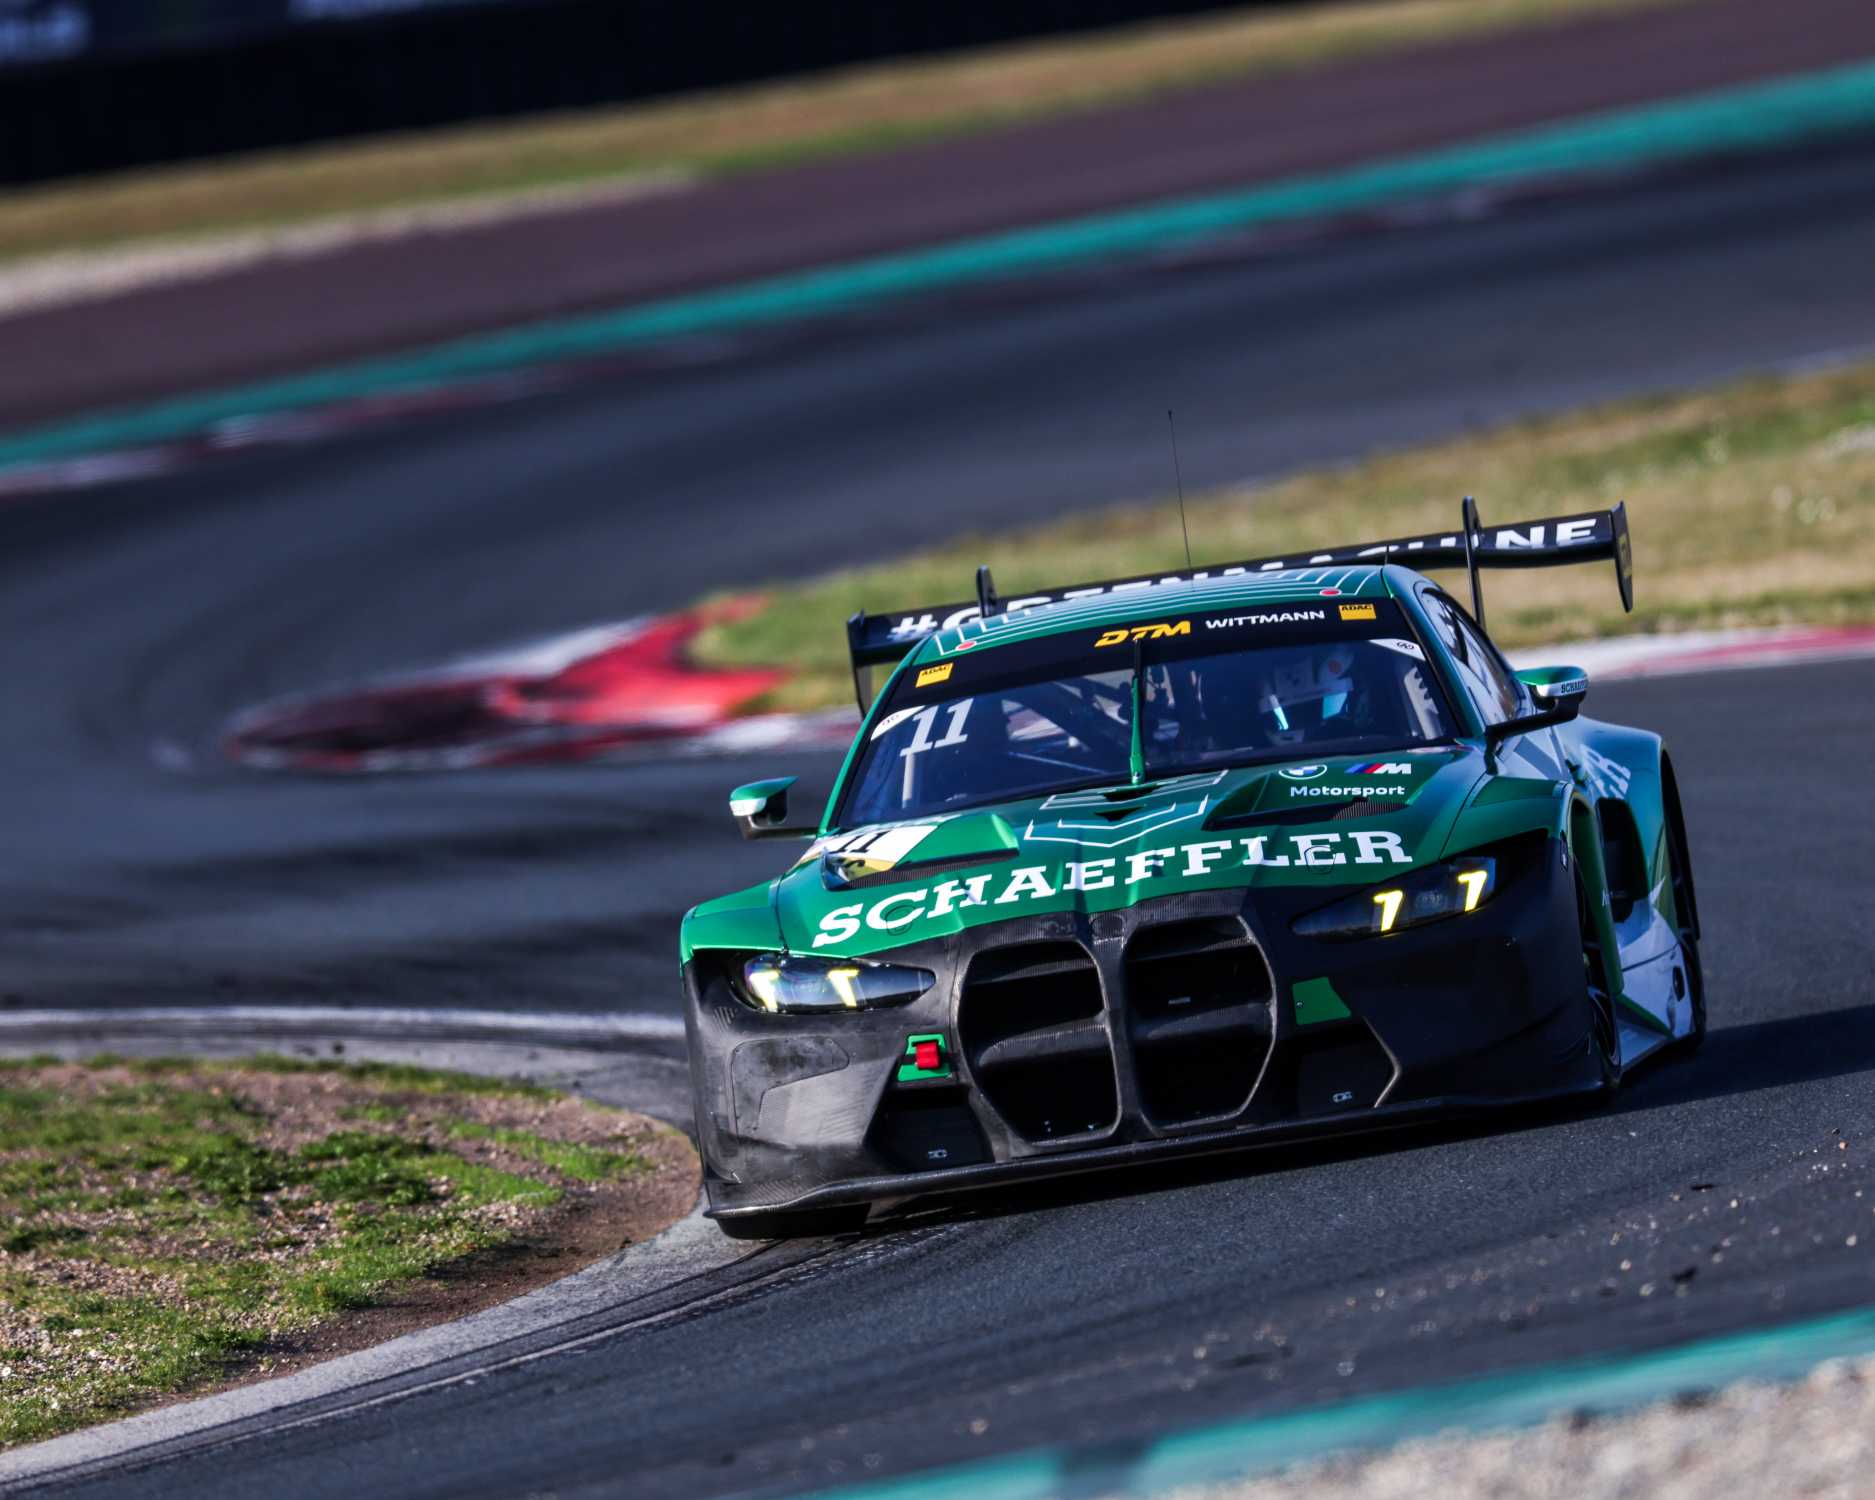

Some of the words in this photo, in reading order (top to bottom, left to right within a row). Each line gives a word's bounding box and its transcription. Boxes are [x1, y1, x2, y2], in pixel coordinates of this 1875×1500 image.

[1205, 609, 1326, 629] WITTMANN
[1094, 620, 1191, 647] DTM
[899, 698, 974, 757] 11
[1289, 785, 1406, 798] Motorsport
[812, 830, 1414, 949] SCHAEFFLER
